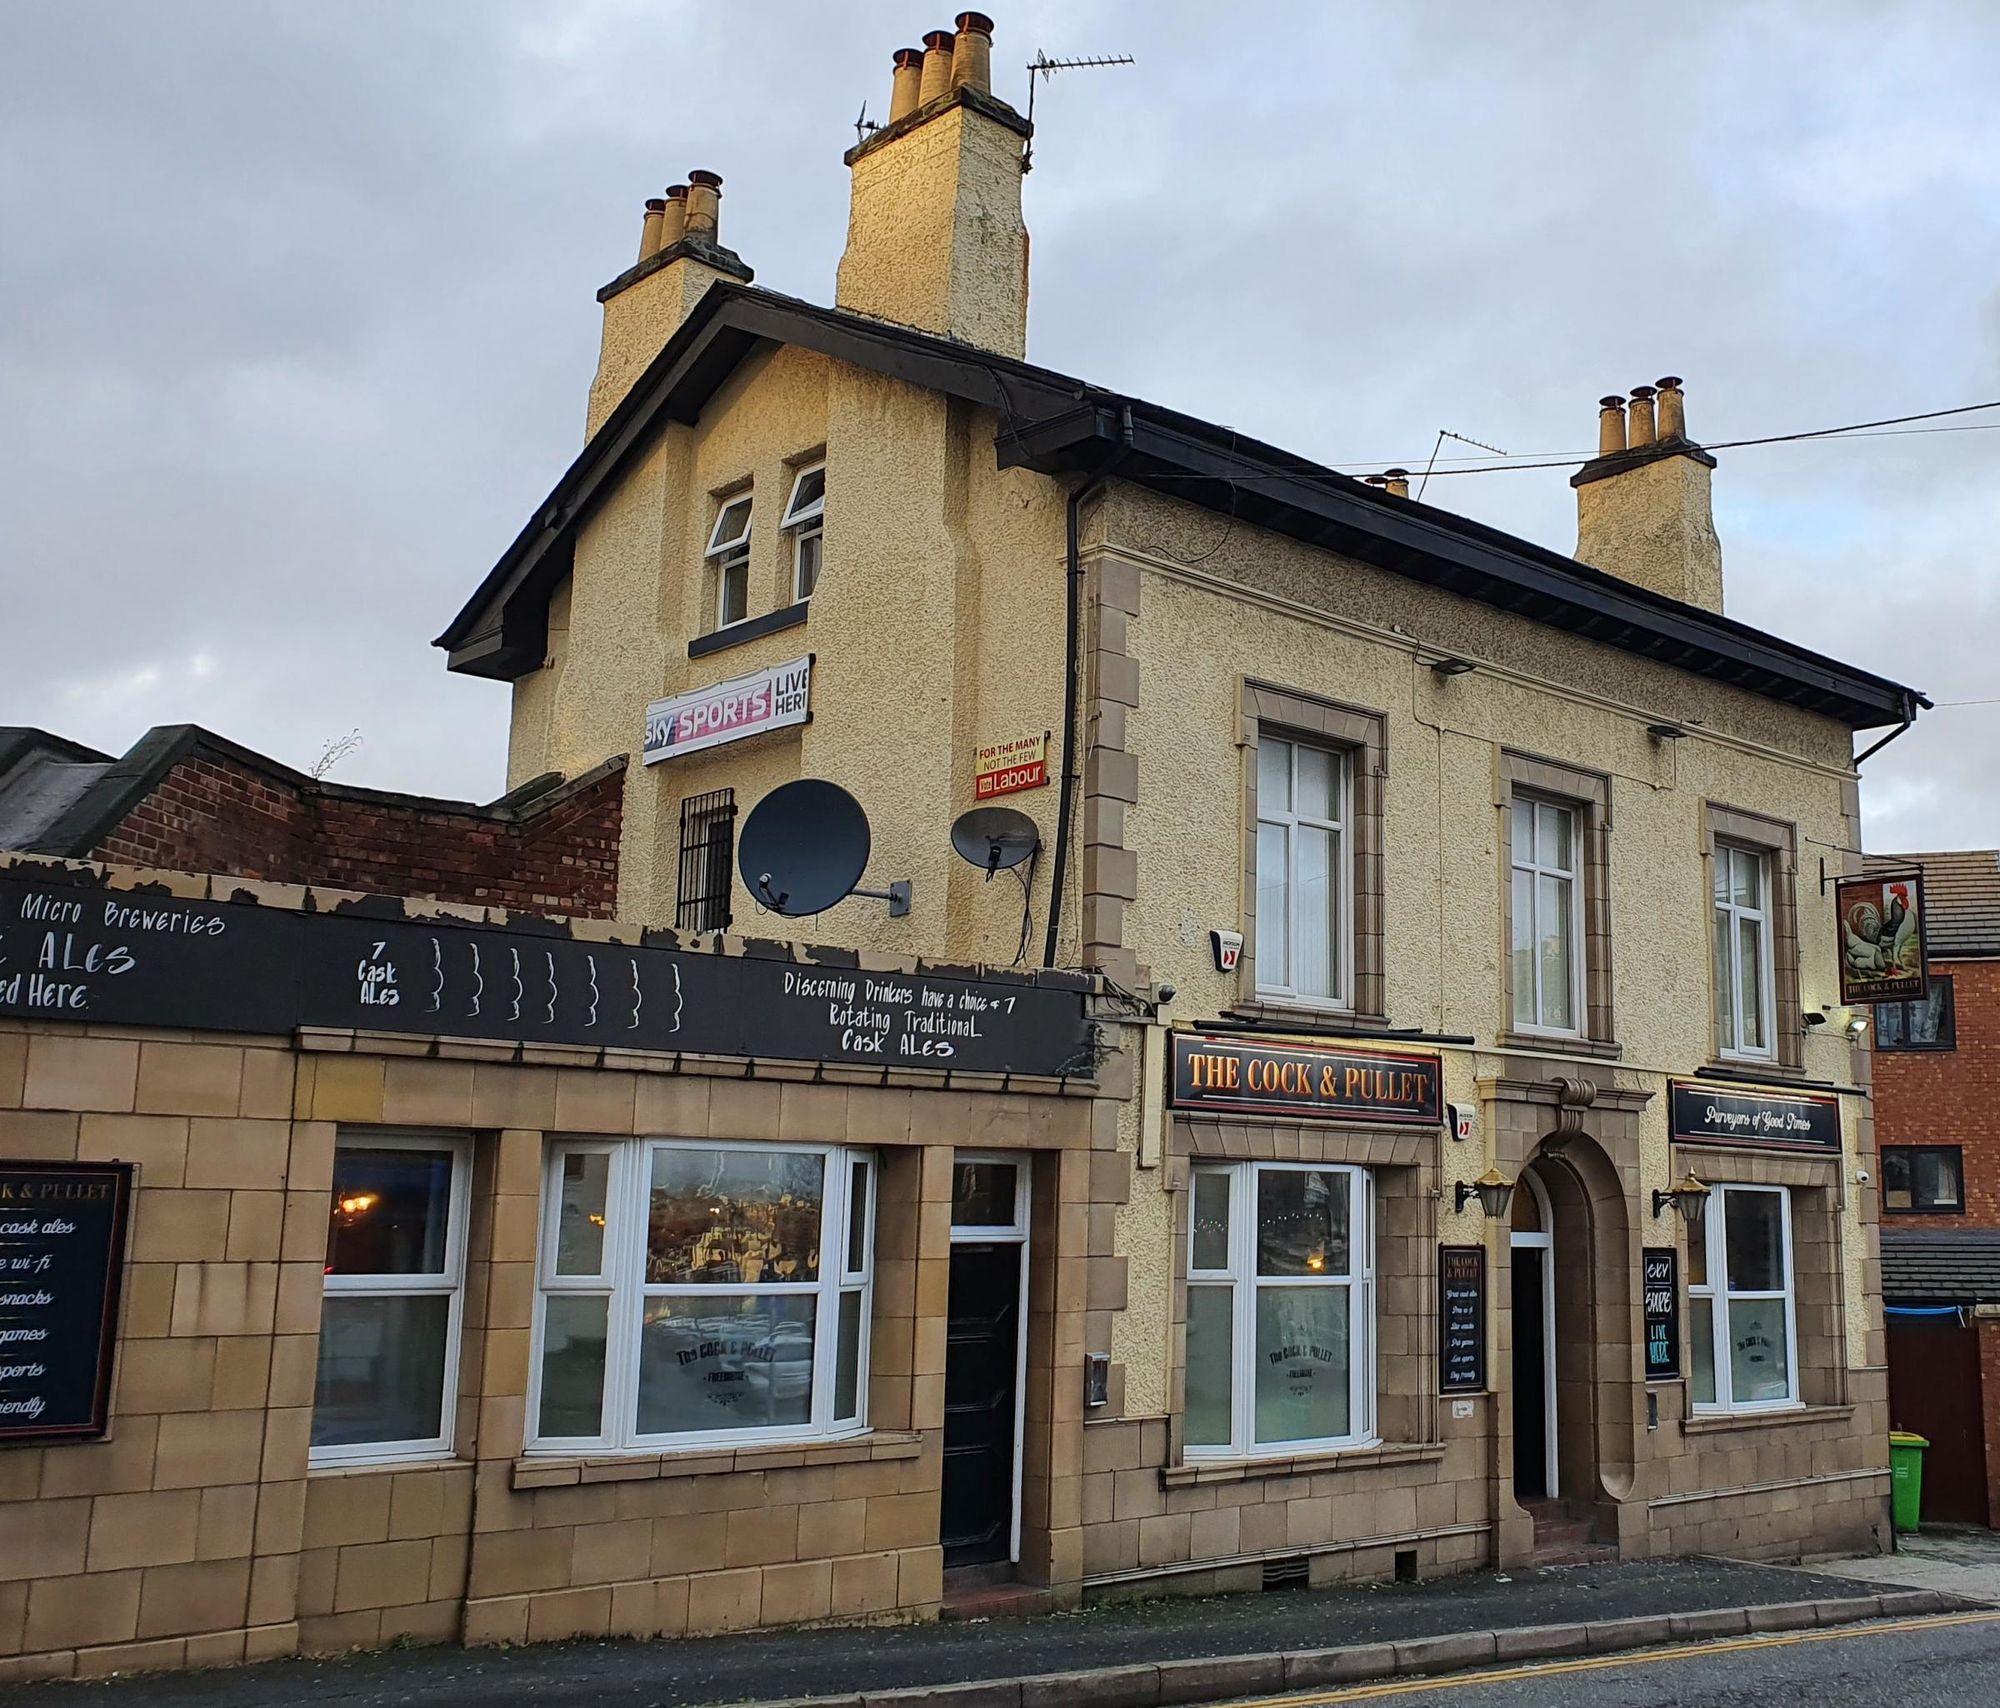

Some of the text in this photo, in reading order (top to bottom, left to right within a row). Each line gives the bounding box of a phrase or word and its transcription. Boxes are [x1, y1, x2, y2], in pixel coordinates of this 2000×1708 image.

[679, 688, 768, 738] SPORTS
[980, 736, 1041, 760] FOR THE MANY
[983, 750, 1037, 771] NOT THE FEW
[993, 766, 1041, 790] Labour
[20, 893, 226, 936] Micro Breweries
[372, 941, 386, 960] 7
[358, 959, 398, 984] Cask
[783, 971, 856, 1004] Discerning
[865, 978, 913, 1004] Drinkers
[921, 985, 944, 1008] have
[947, 993, 954, 1009] a
[959, 988, 988, 1012] choice
[1004, 996, 1016, 1014] 7
[829, 1002, 891, 1034] Rotating
[841, 1028, 885, 1053] Cask
[1188, 1053, 1428, 1103] THE COCK & PULLET
[1704, 1105, 1811, 1131] Purveyors of Good Times
[20, 1183, 33, 1199] &
[0, 1218, 77, 1234] cask ales
[11, 1254, 53, 1274] wi-fi
[1647, 1262, 1669, 1278] SKY
[0, 1362, 47, 1381] ports
